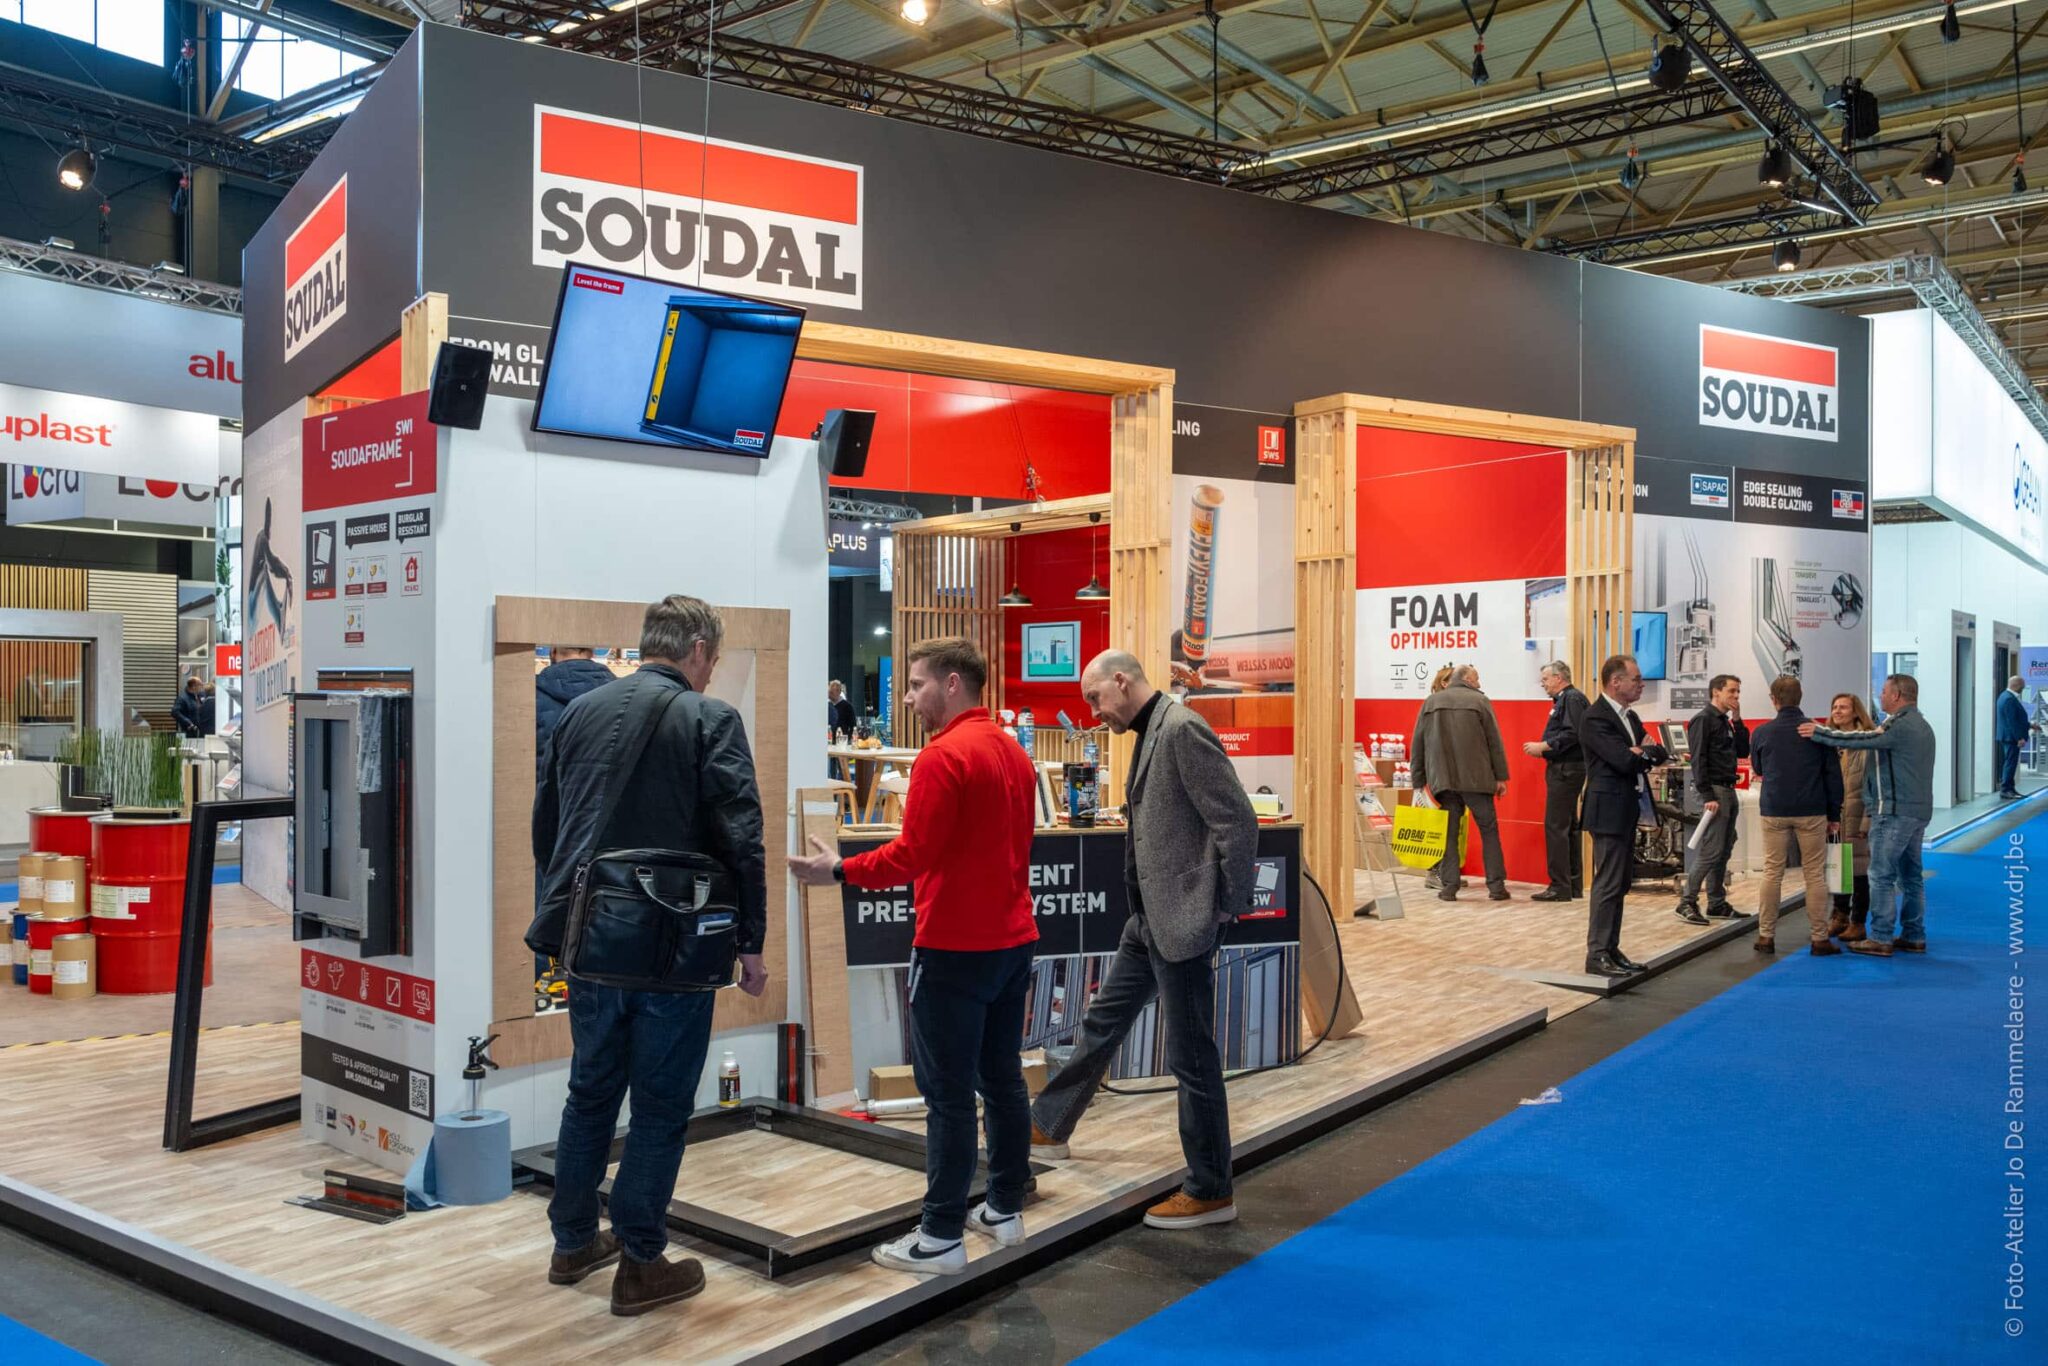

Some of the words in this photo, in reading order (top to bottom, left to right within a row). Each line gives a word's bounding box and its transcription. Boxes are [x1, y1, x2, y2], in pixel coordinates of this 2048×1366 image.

[540, 188, 857, 296] SOUDAL
[577, 277, 593, 285] Level
[603, 282, 620, 291] frame
[286, 250, 345, 350] SOUDAL
[1703, 376, 1835, 433] SOUDAL
[395, 418, 413, 436] SWI
[734, 437, 762, 446] SOUDAL
[331, 438, 402, 470] SOUDAFRAME
[1263, 450, 1280, 460] SWS
[1743, 481, 1766, 494] EDGE
[1767, 483, 1803, 498] SEALING
[1743, 495, 1777, 509] DOUBLE
[1778, 497, 1813, 512] GLAZING
[398, 512, 423, 524] BURGLAR
[347, 525, 369, 537] PASSIVE
[370, 522, 388, 534] HOUSE
[398, 524, 428, 536] RESISTANT
[1391, 592, 1478, 629] FOAM
[1391, 630, 1478, 650] OPTIMISER
[1219, 733, 1250, 741] PRODUCT
[1029, 864, 1075, 887] ENT
[332, 1052, 349, 1067] TESTED
[354, 1060, 378, 1077] APPROVED
[379, 1068, 400, 1083] QUALITY
